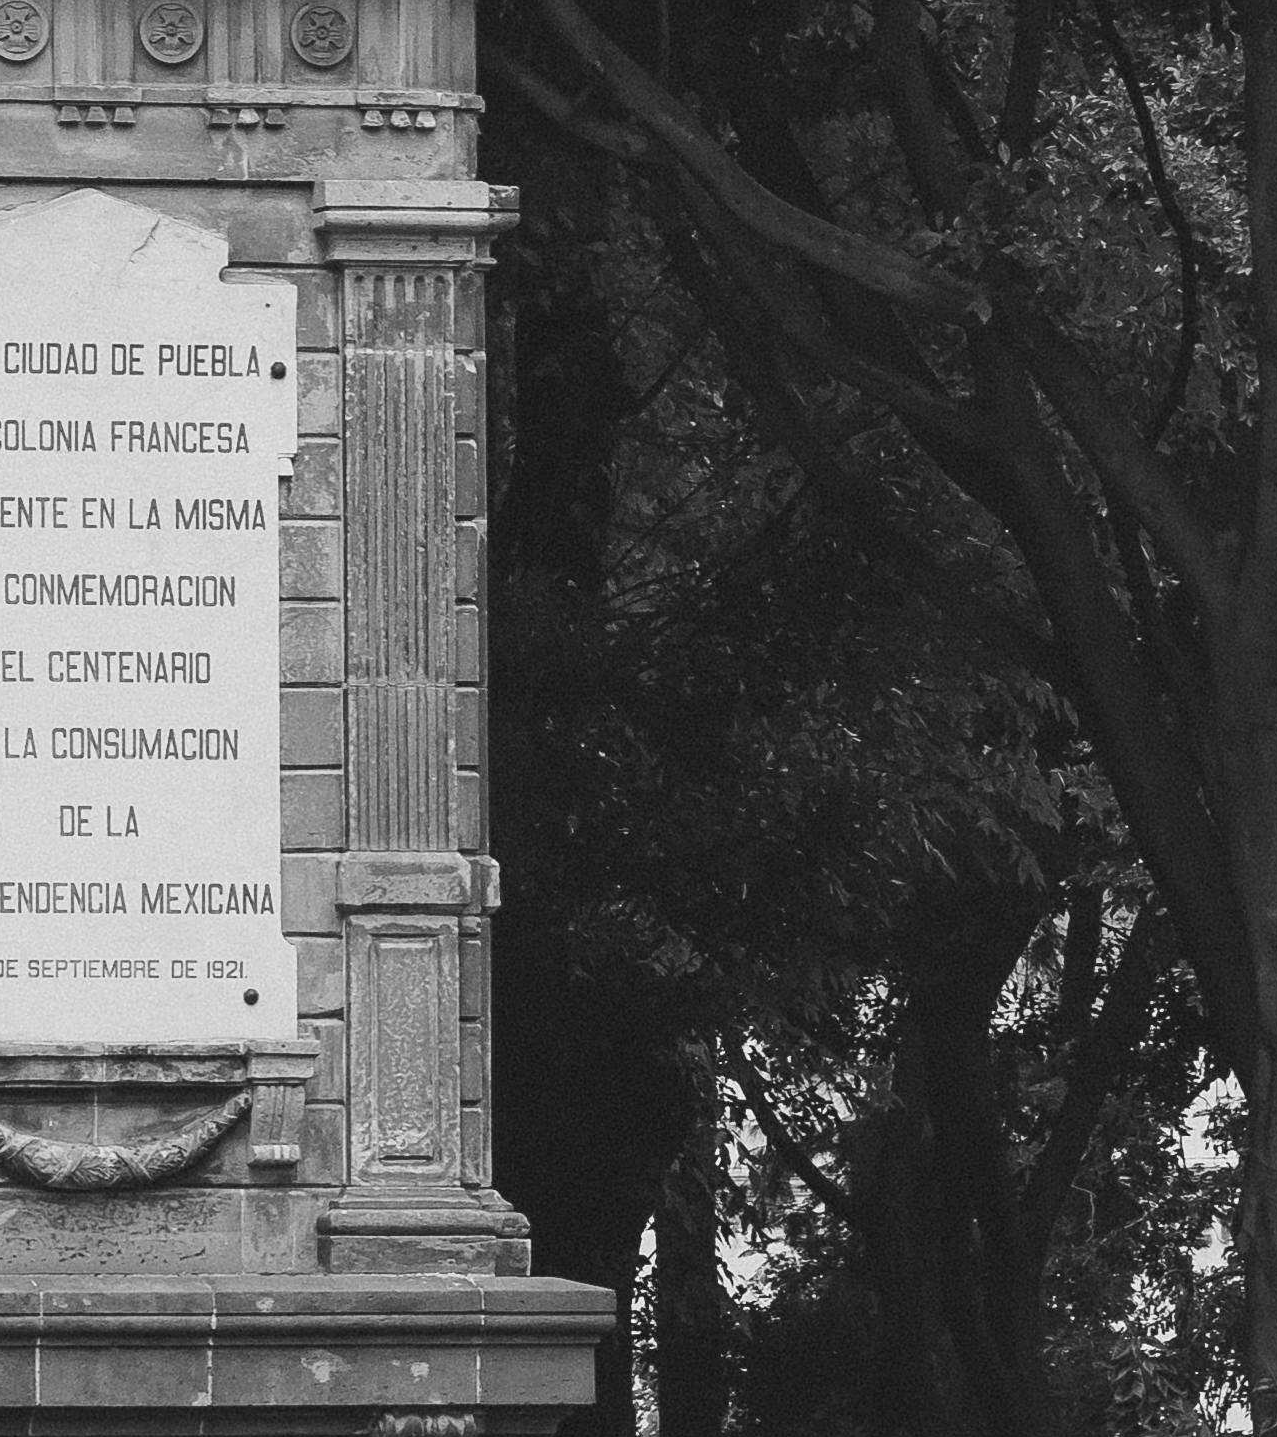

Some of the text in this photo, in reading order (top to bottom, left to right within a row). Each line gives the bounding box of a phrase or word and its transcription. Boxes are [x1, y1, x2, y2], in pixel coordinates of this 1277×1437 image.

[5, 343, 97, 374] CIUDAD
[112, 344, 144, 375] DE
[159, 345, 259, 376] PUEBLA
[112, 421, 249, 453] FRANCESA
[83, 498, 114, 528] EN
[130, 499, 160, 529] LA
[176, 499, 265, 530] MISMA
[5, 574, 235, 606] CONMEMORACION
[49, 651, 210, 683] CENTENARIO
[5, 728, 37, 758] LA
[52, 728, 238, 760] CONSUMACION
[60, 806, 138, 836] DE LA
[142, 883, 274, 914] MEXICANA
[29, 960, 159, 978] SEPTIEMBRE
[172, 960, 197, 978] DE
[207, 961, 248, 978] 1921.
